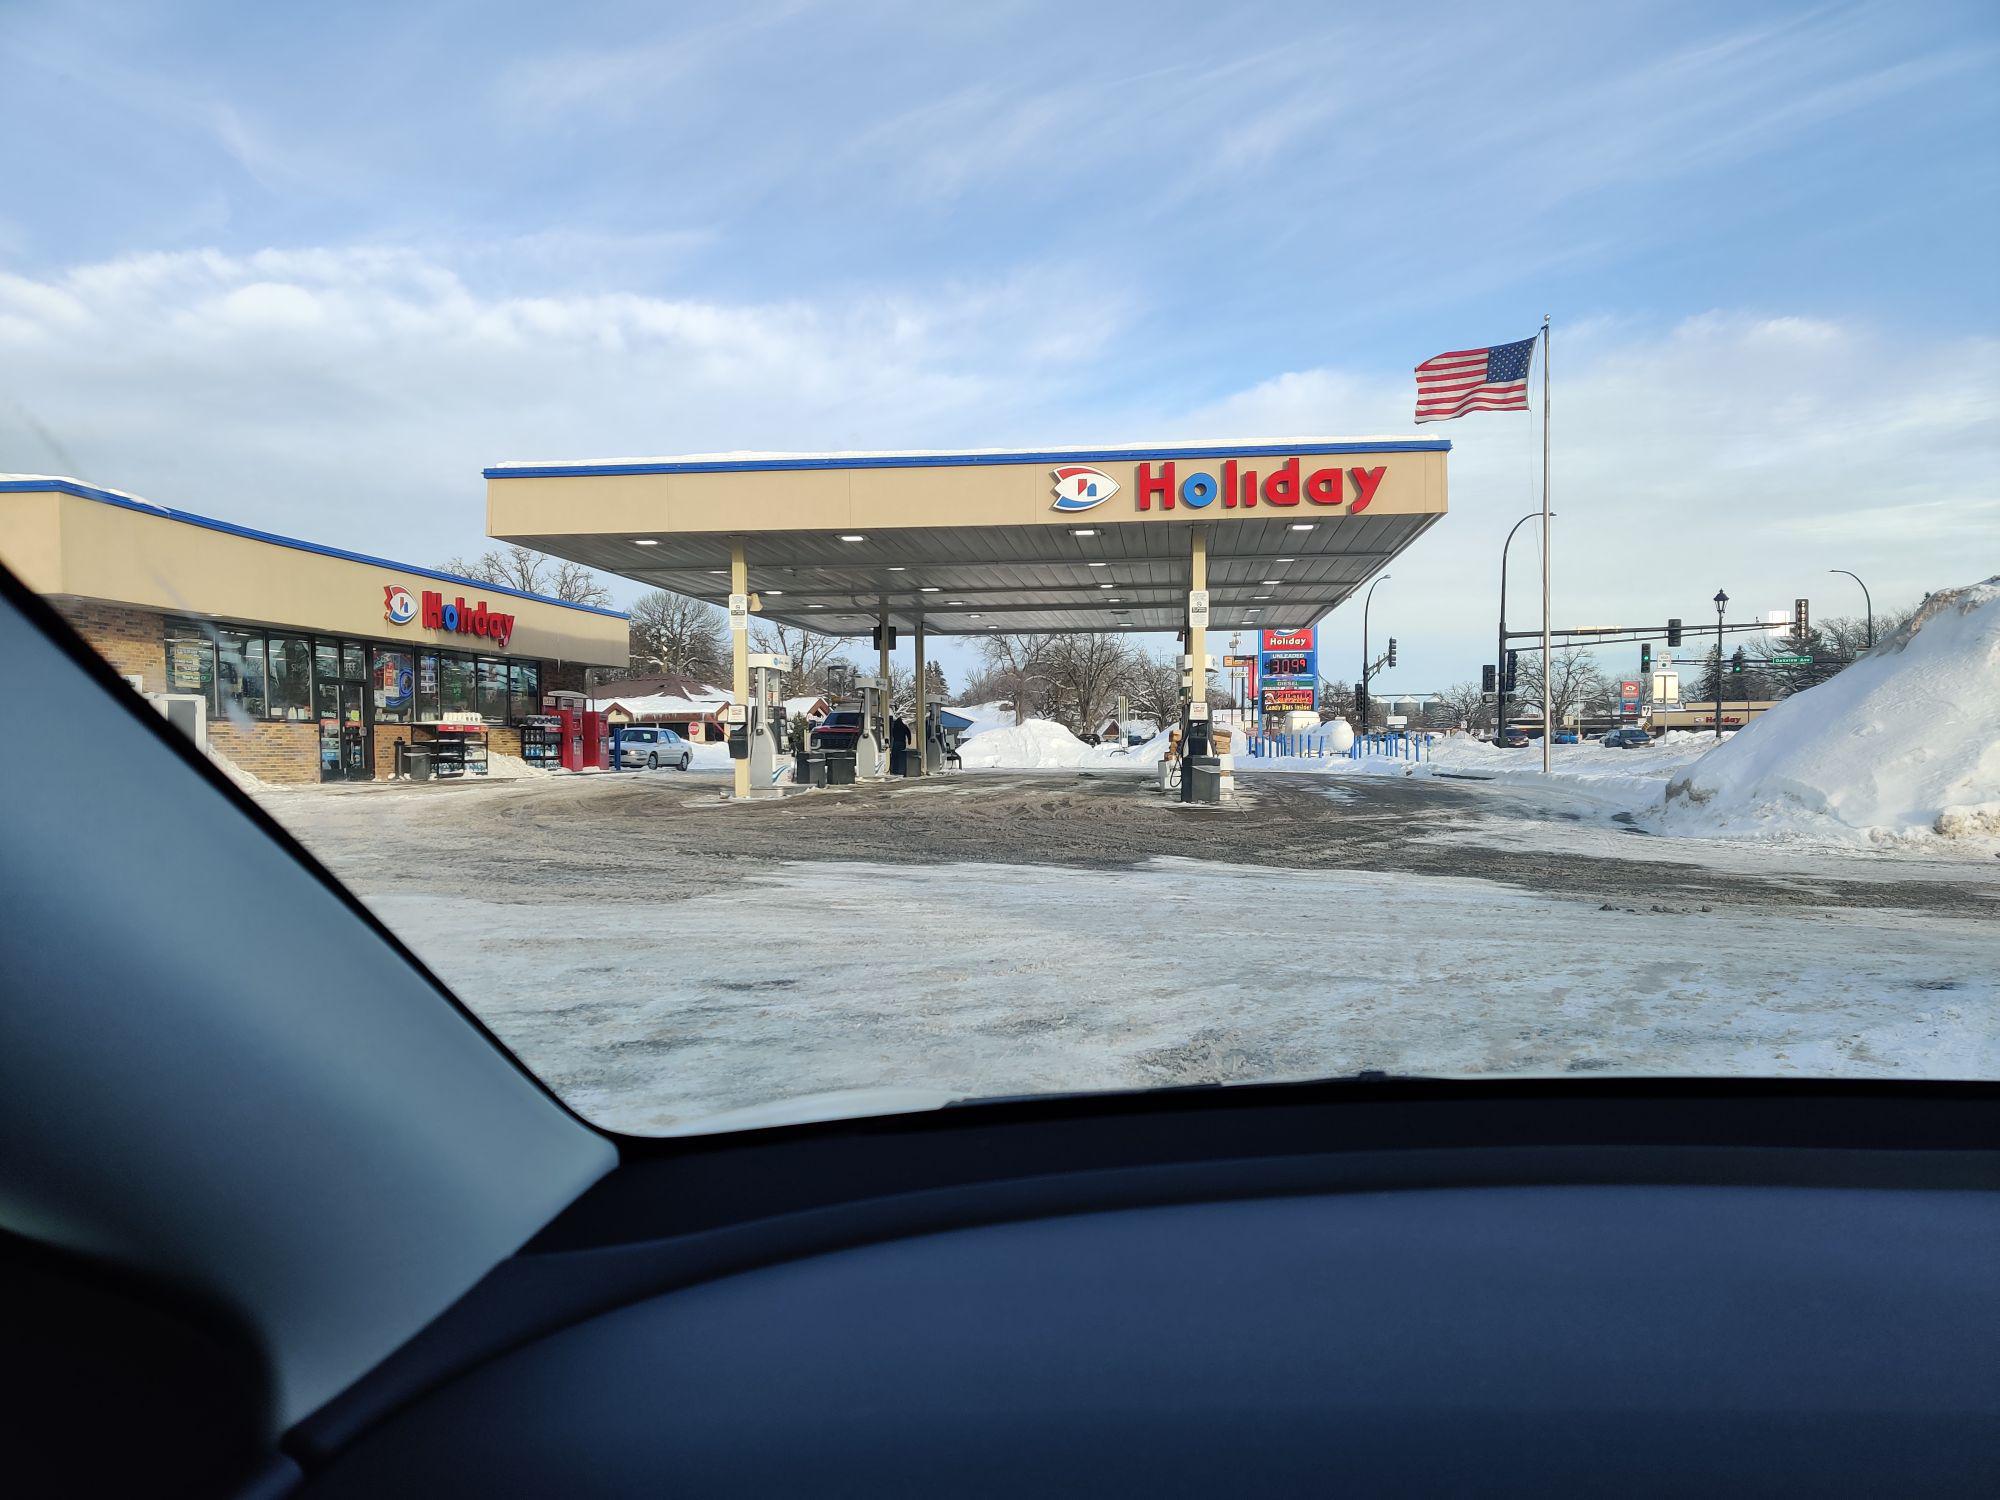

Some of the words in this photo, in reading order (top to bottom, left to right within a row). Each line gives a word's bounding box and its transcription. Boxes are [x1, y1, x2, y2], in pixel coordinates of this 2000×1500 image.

[1139, 457, 1387, 514] Holiday
[422, 591, 515, 647] Holiday
[1270, 637, 1306, 646] Holiday
